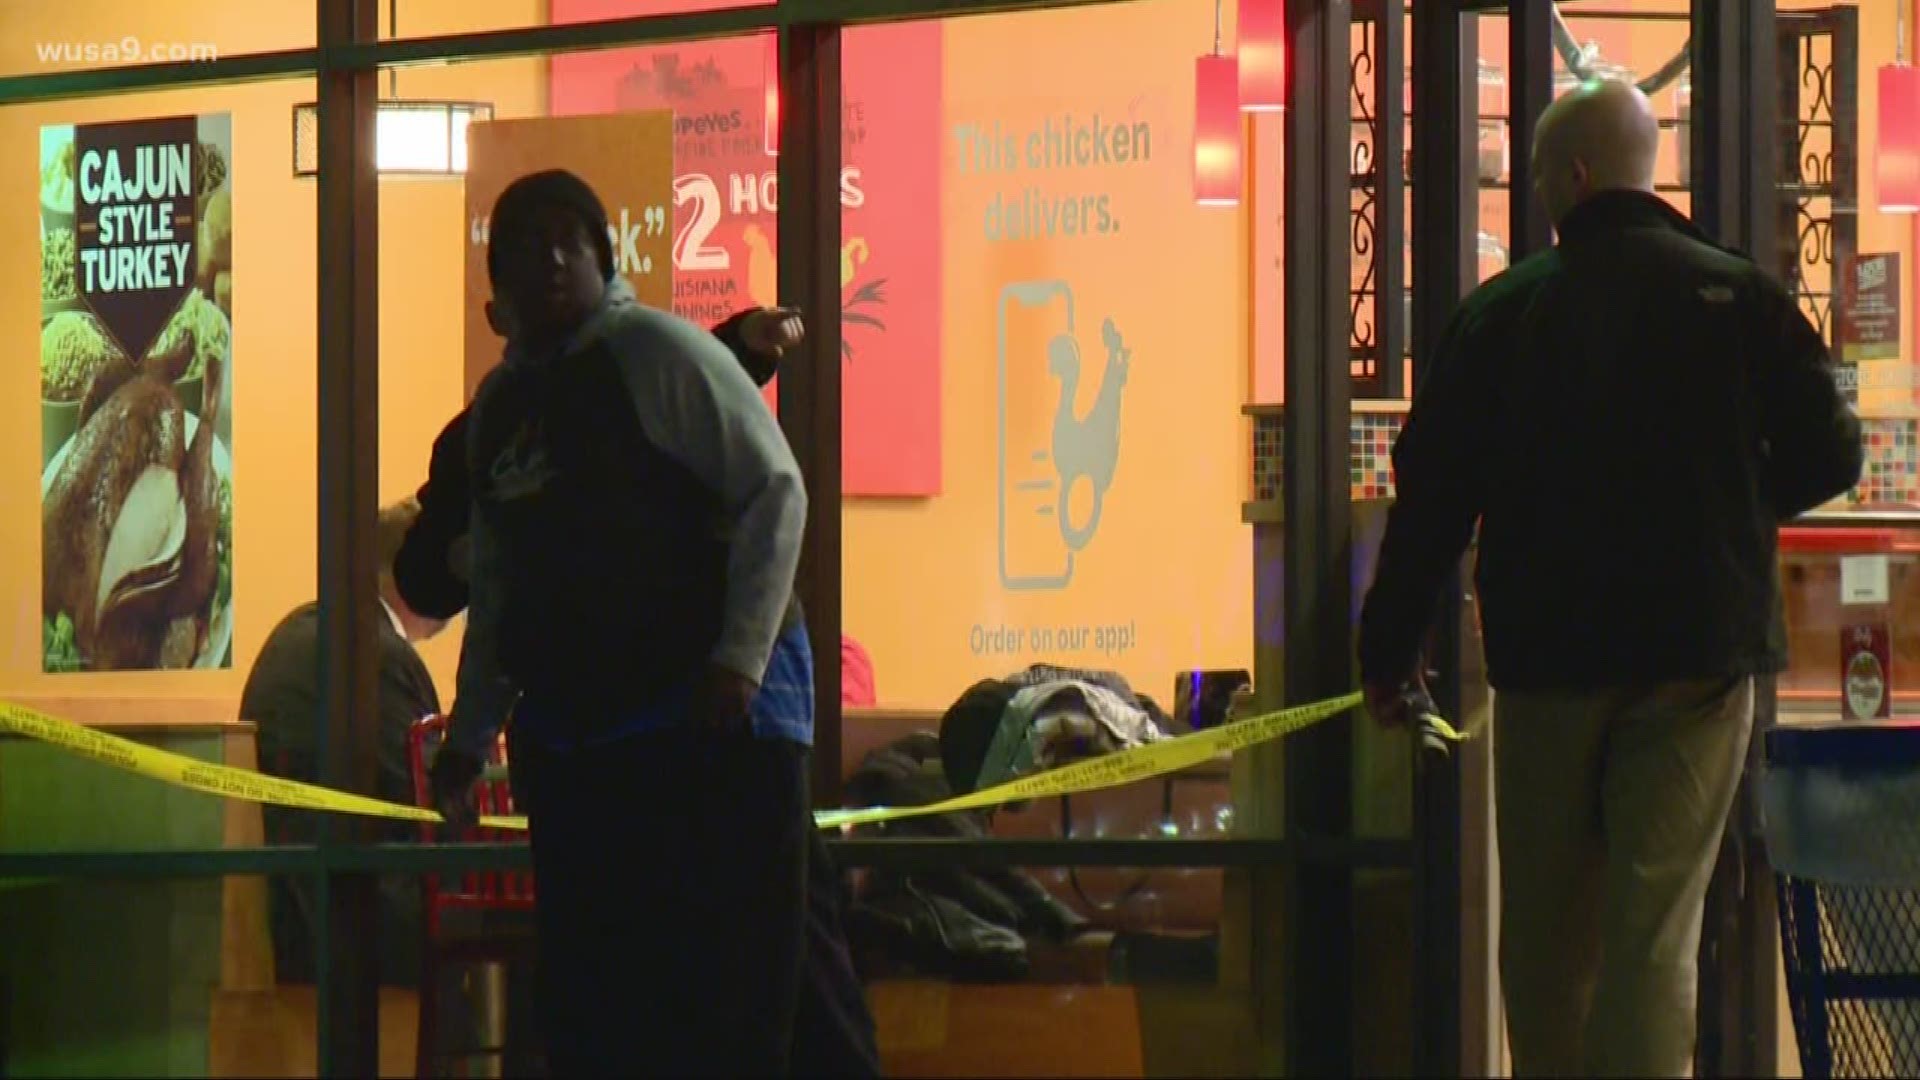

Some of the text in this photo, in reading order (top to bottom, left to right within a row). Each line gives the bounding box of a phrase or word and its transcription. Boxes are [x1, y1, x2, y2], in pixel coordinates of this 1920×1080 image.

[954, 113, 1151, 174] This chicken
[80, 143, 190, 204] CAJUN
[729, 166, 865, 214] HOS
[99, 202, 174, 245] STYLE
[984, 188, 1120, 242] delivers.
[80, 242, 191, 293] TURKEY
[970, 620, 1136, 657] Order on our app!
